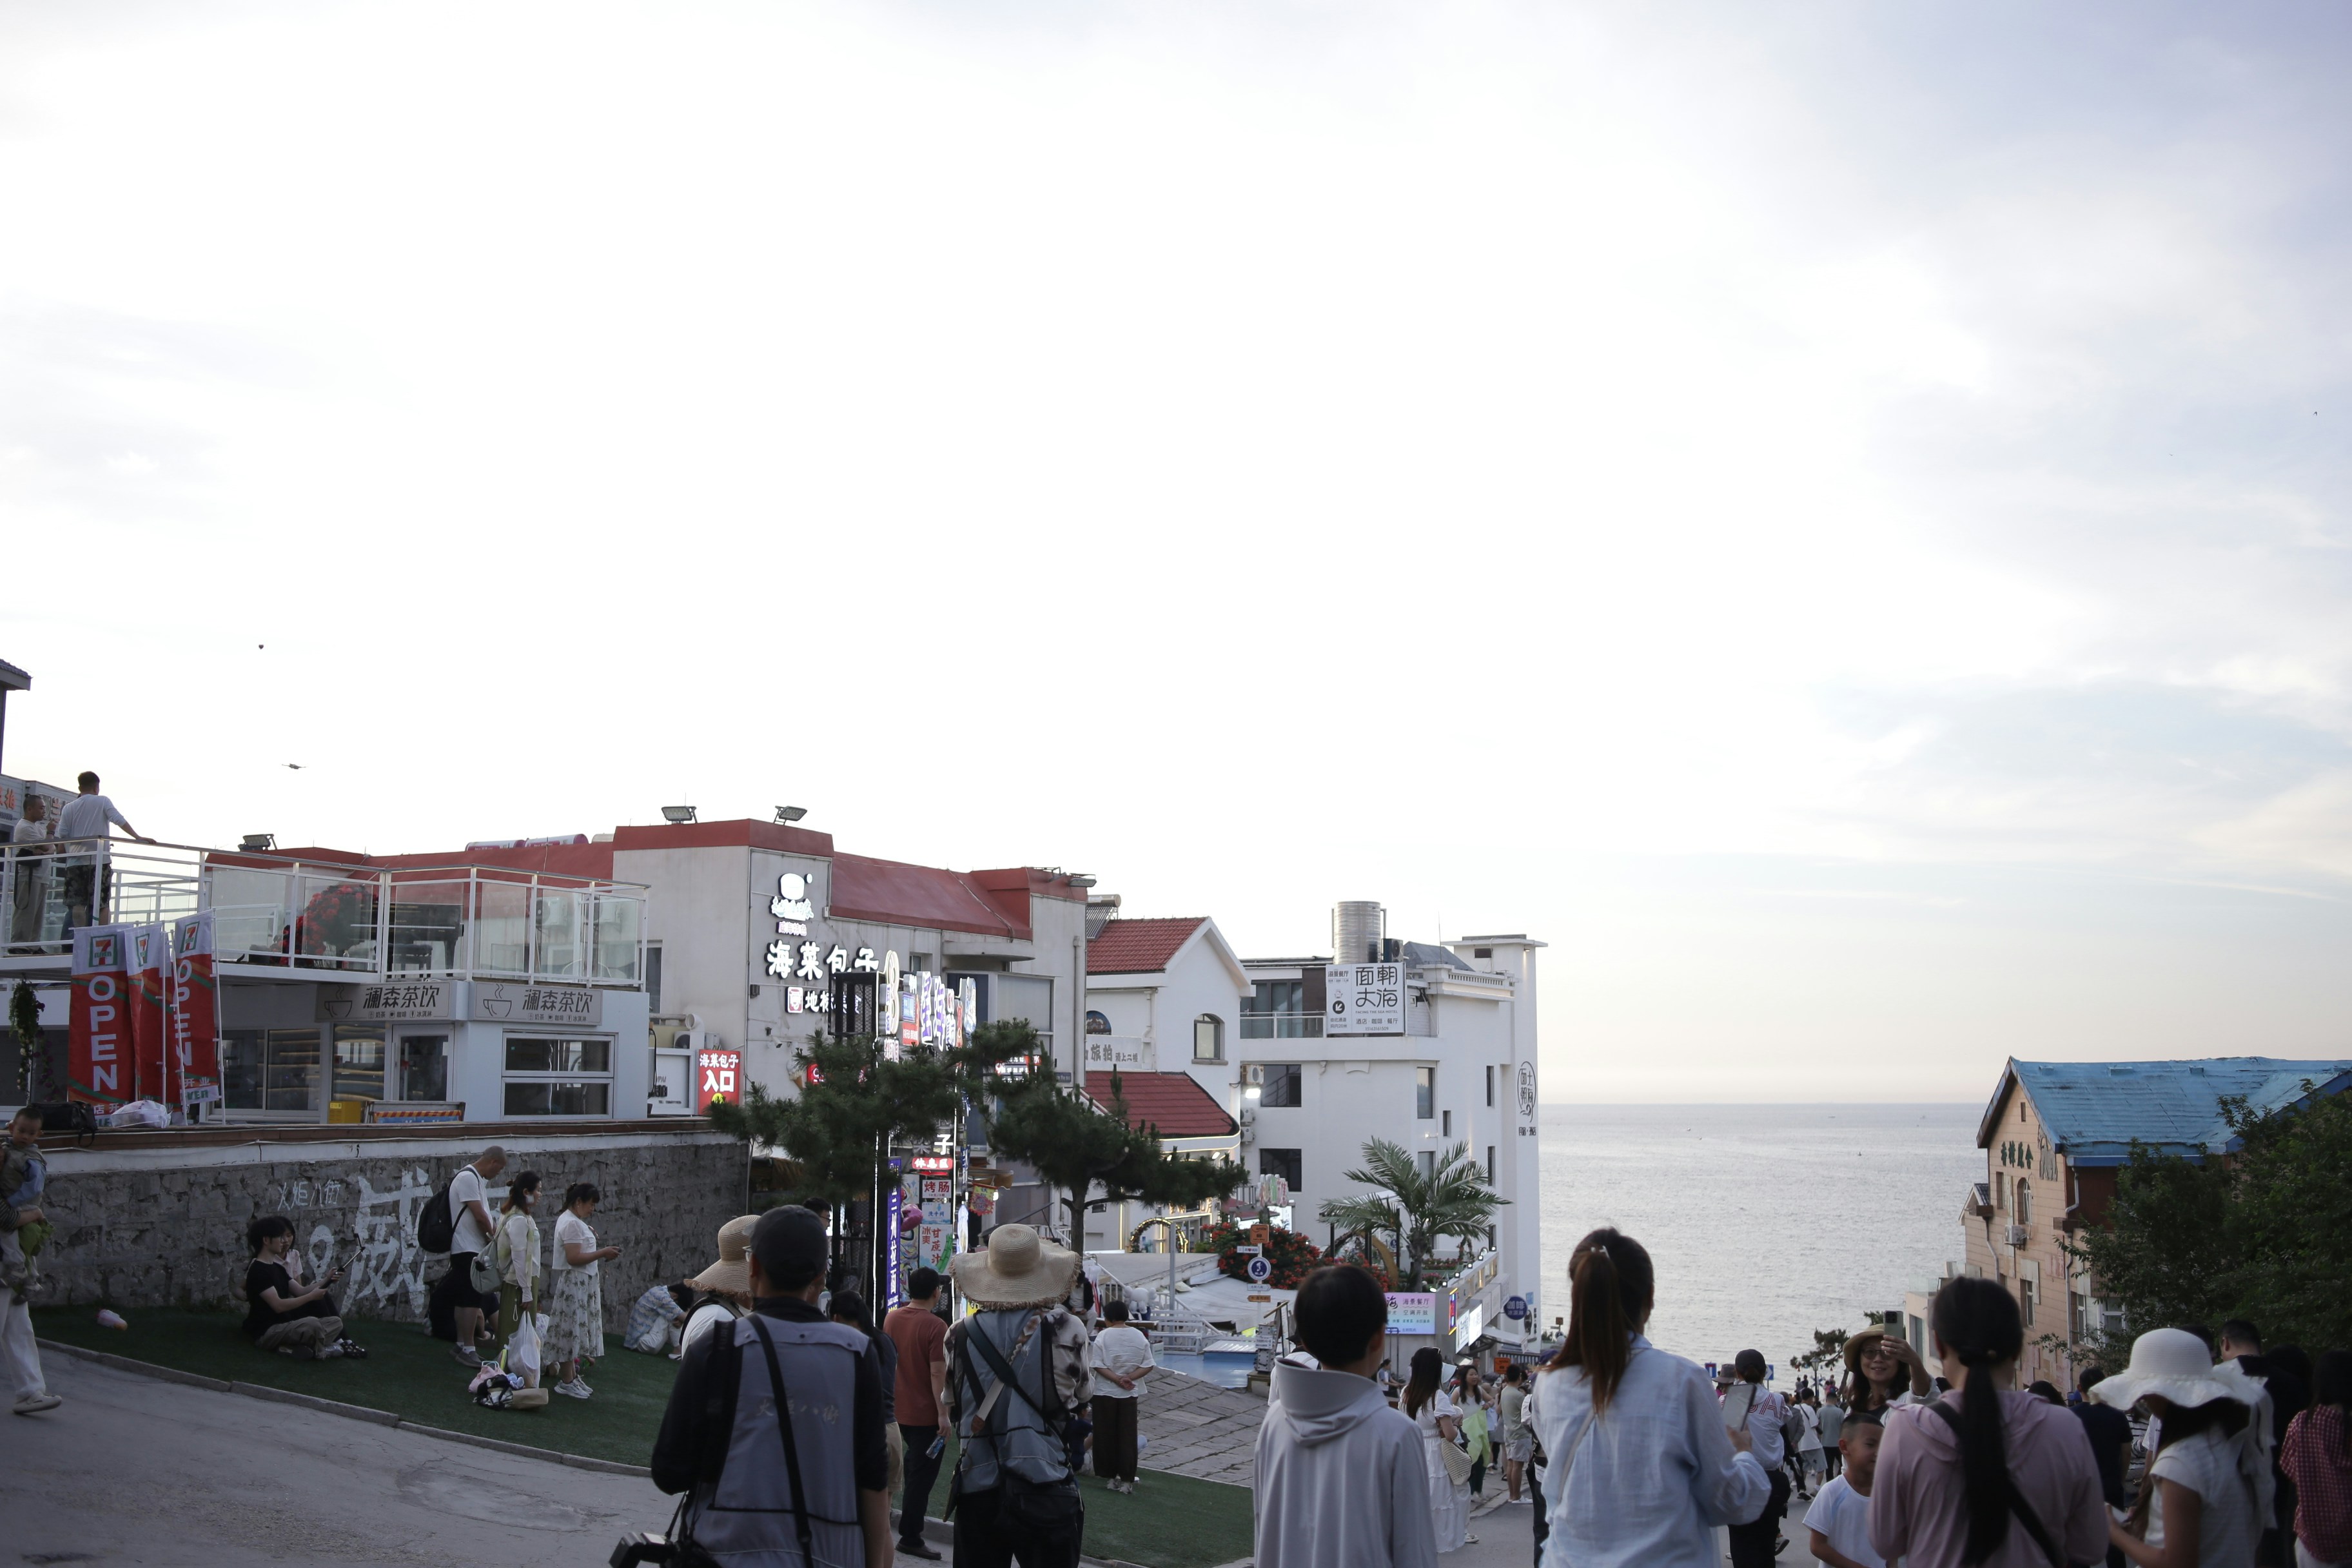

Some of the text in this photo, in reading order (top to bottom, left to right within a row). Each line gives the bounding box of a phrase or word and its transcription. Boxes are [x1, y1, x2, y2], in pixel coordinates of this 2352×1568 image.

[95, 939, 112, 965] 7
[767, 940, 879, 981] 海菜包子
[363, 985, 440, 1009] 澜森茶饮
[522, 989, 593, 1013] 澜森茶饮
[88, 975, 117, 1092] OPEN
[700, 1053, 739, 1068] 海菜包子
[703, 1070, 735, 1093] 入口
[914, 1158, 949, 1169] 休息区
[277, 1179, 341, 1212] 火炬八街
[925, 1181, 950, 1193] 烤肠
[922, 1226, 931, 1244] 冰爽
[930, 1228, 941, 1264] 甘蔗汁
[1506, 1300, 1525, 1309] 咖啡
